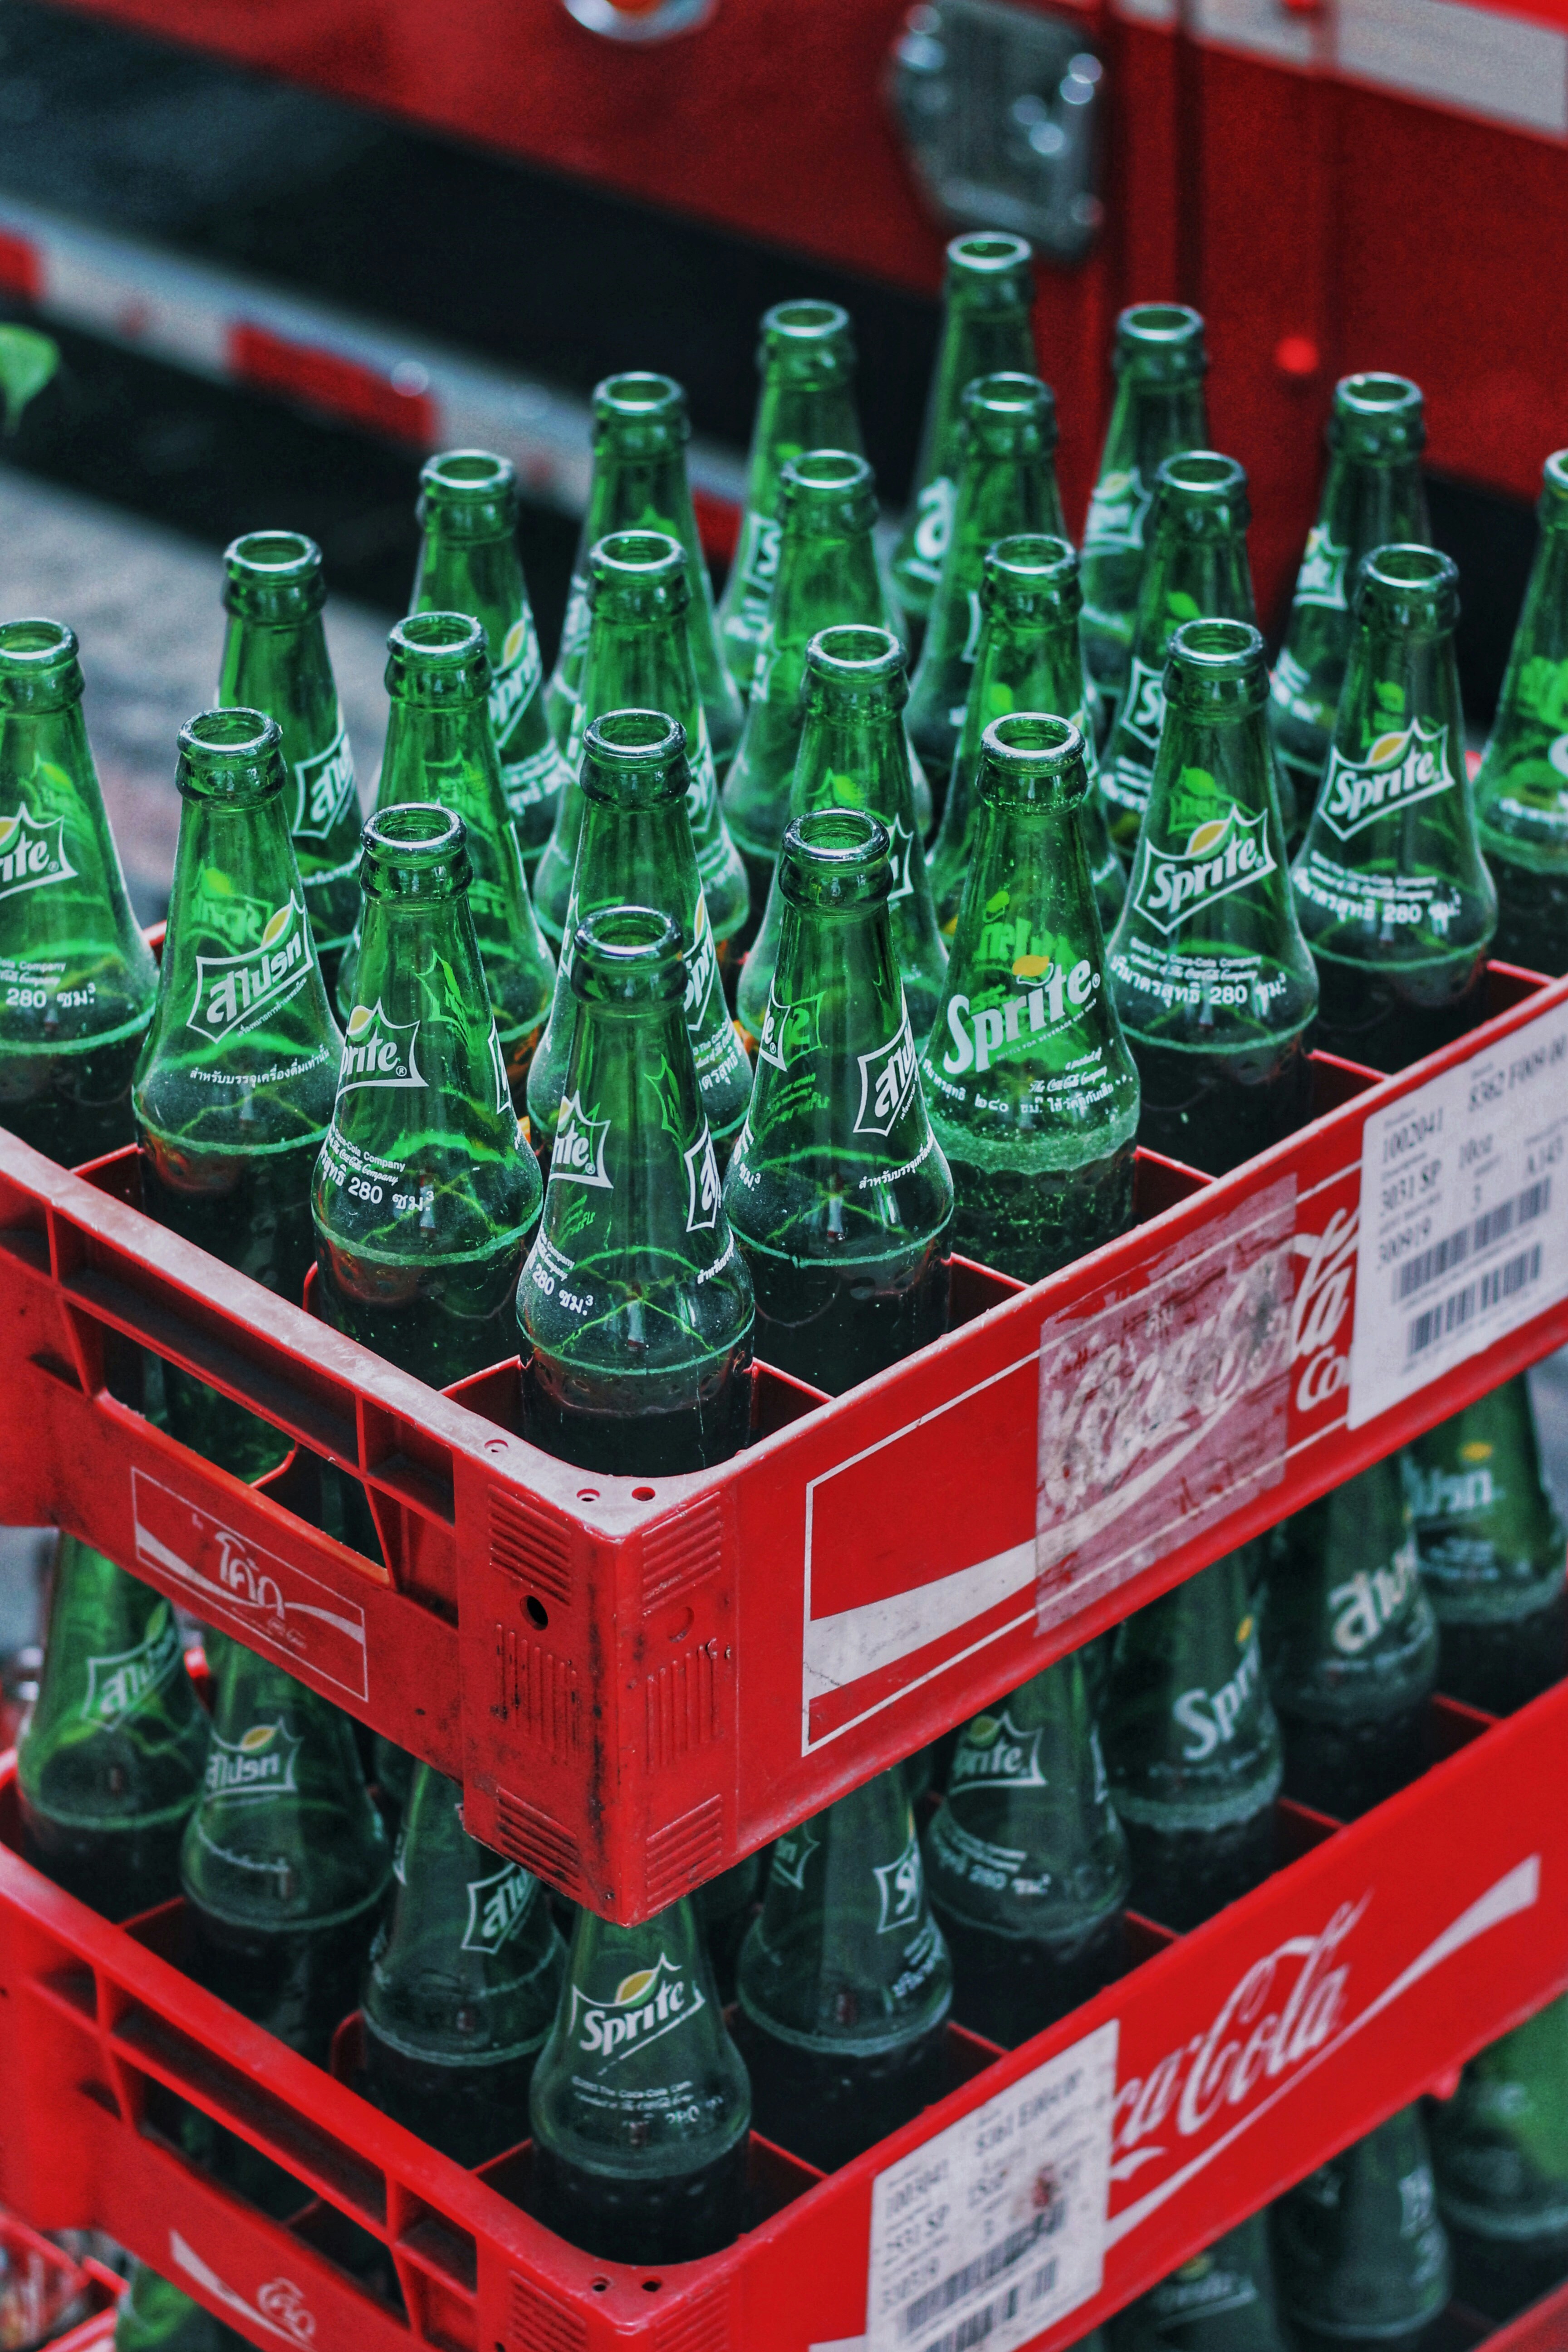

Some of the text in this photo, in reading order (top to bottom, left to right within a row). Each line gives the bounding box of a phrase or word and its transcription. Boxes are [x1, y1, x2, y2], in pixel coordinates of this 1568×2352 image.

[1329, 744, 1436, 816] Sprite
[1147, 832, 1257, 913] Sprite
[1382, 903, 1422, 924] 280
[19, 960, 66, 973] Company
[6, 987, 46, 1009] 280
[1209, 985, 1248, 1005] 280
[943, 959, 1092, 1074] Sprite
[1022, 1039, 1037, 1049] FOR
[1039, 1019, 1072, 1043] BEVERAGE
[1073, 1010, 1085, 1022] USE
[362, 1163, 399, 1186] Company
[363, 1151, 406, 1172] Company
[348, 1176, 383, 1204] 280
[547, 1240, 575, 1270] Company
[532, 1263, 555, 1296] 280
